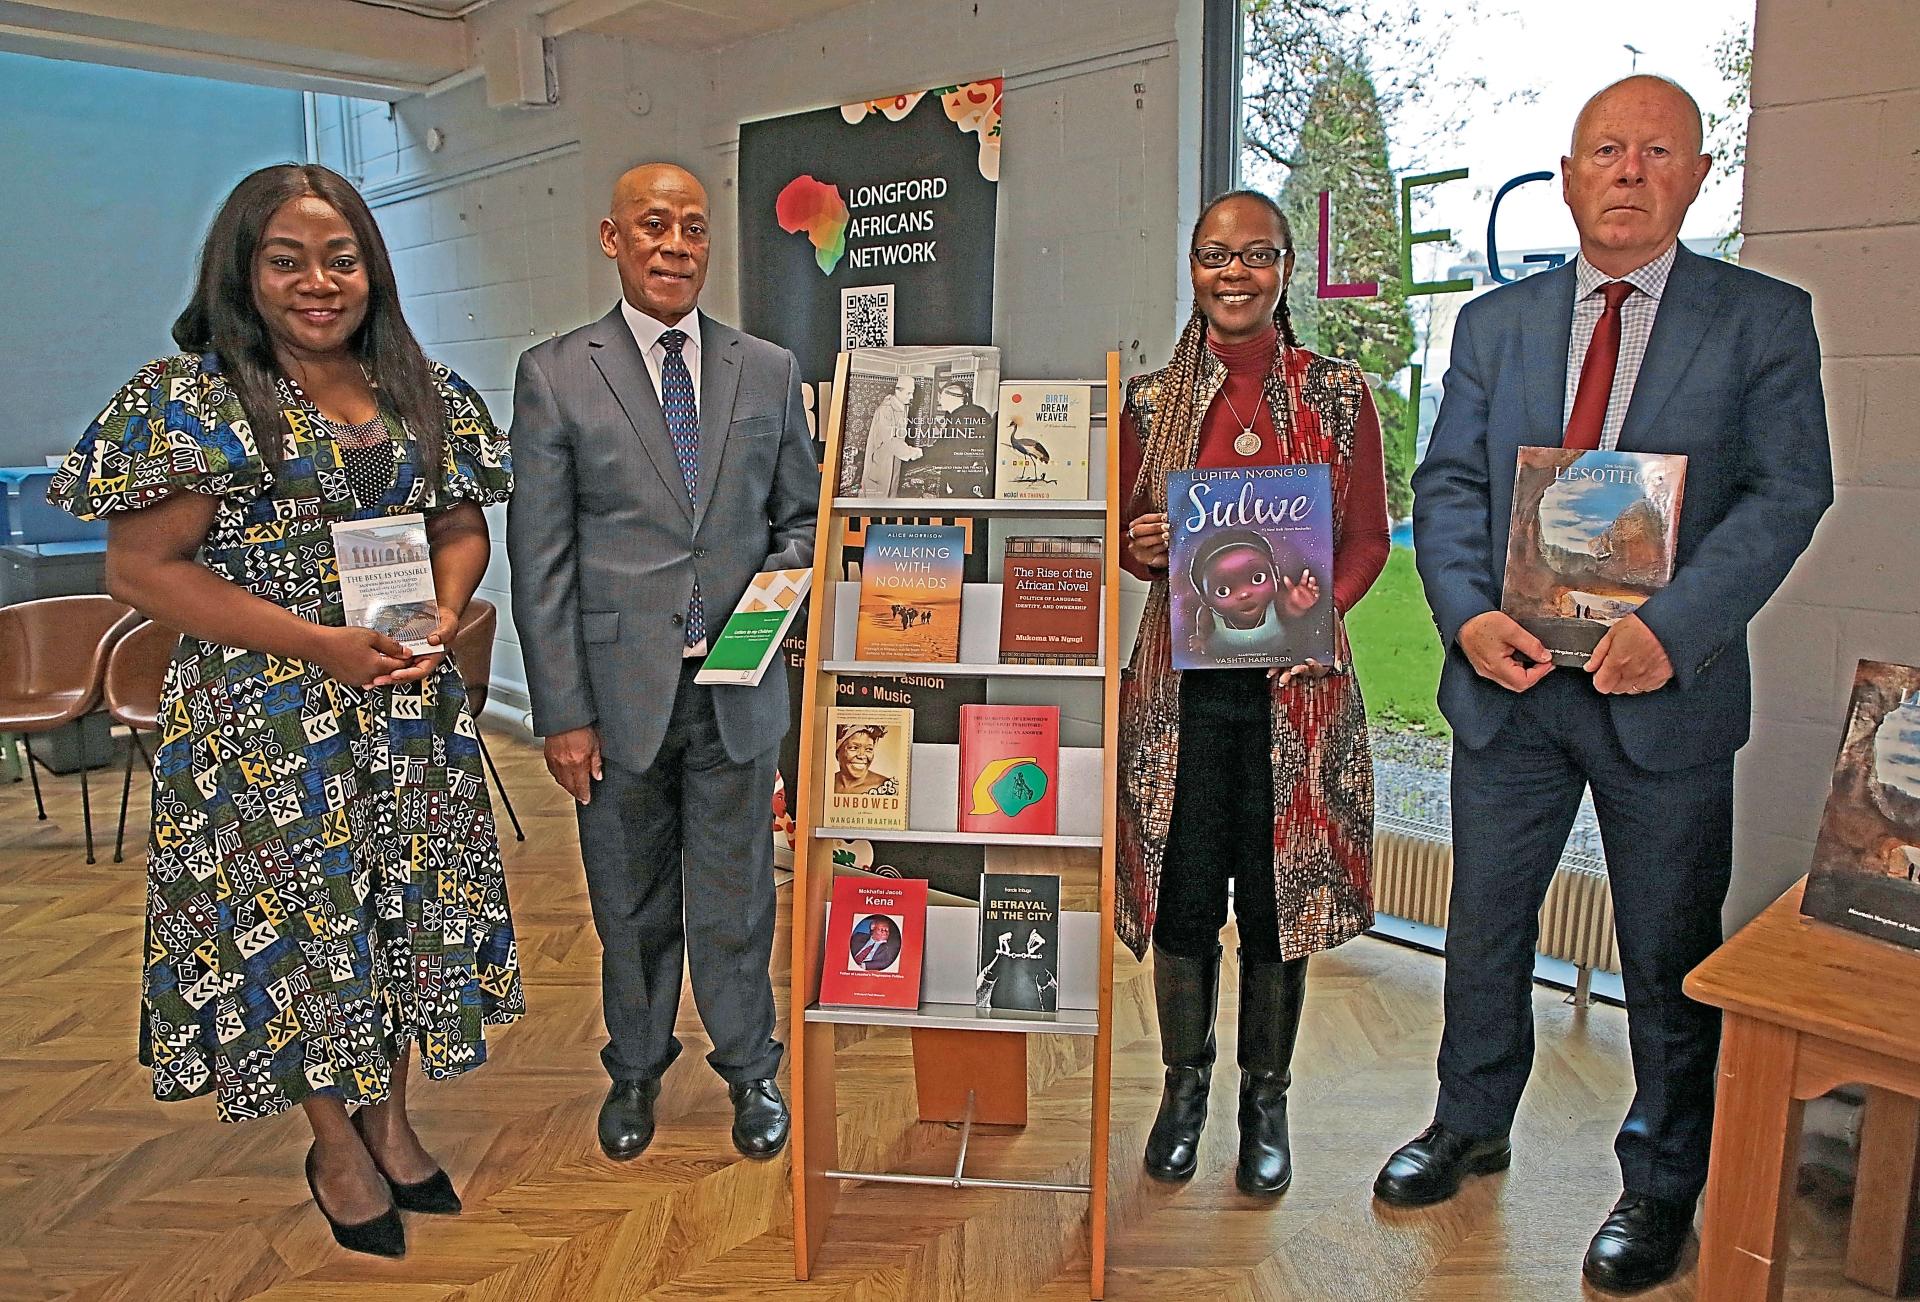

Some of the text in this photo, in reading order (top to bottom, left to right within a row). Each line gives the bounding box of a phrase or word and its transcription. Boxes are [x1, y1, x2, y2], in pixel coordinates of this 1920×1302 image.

[849, 177, 947, 208] LONGFORD
[849, 210, 934, 239] AFRICANS
[849, 241, 937, 269] NETWORK
[1045, 394, 1069, 403] BIRTH
[1041, 403, 1068, 413] DREAM
[903, 417, 986, 425] NCE UPON A TIME
[1035, 412, 1068, 422] WEAVER
[1191, 468, 1307, 481] LUPITA NYONG'O
[1185, 481, 1316, 533] Sulwe
[878, 546, 950, 559] WALKING
[894, 561, 931, 573] WITH
[1013, 567, 1093, 579] The Rise of the
[346, 576, 363, 584] THE
[393, 568, 428, 578] POSSIBLE
[875, 576, 948, 589] NOMADS
[1016, 580, 1089, 592] African Novel
[873, 686, 912, 704] Music
[833, 796, 899, 810] UNBOWED
[867, 818, 901, 826] MAATHAI
[865, 896, 894, 906] Kena
[990, 900, 1048, 911] BETRAYAL
[986, 911, 1053, 921] IN THE CITY
